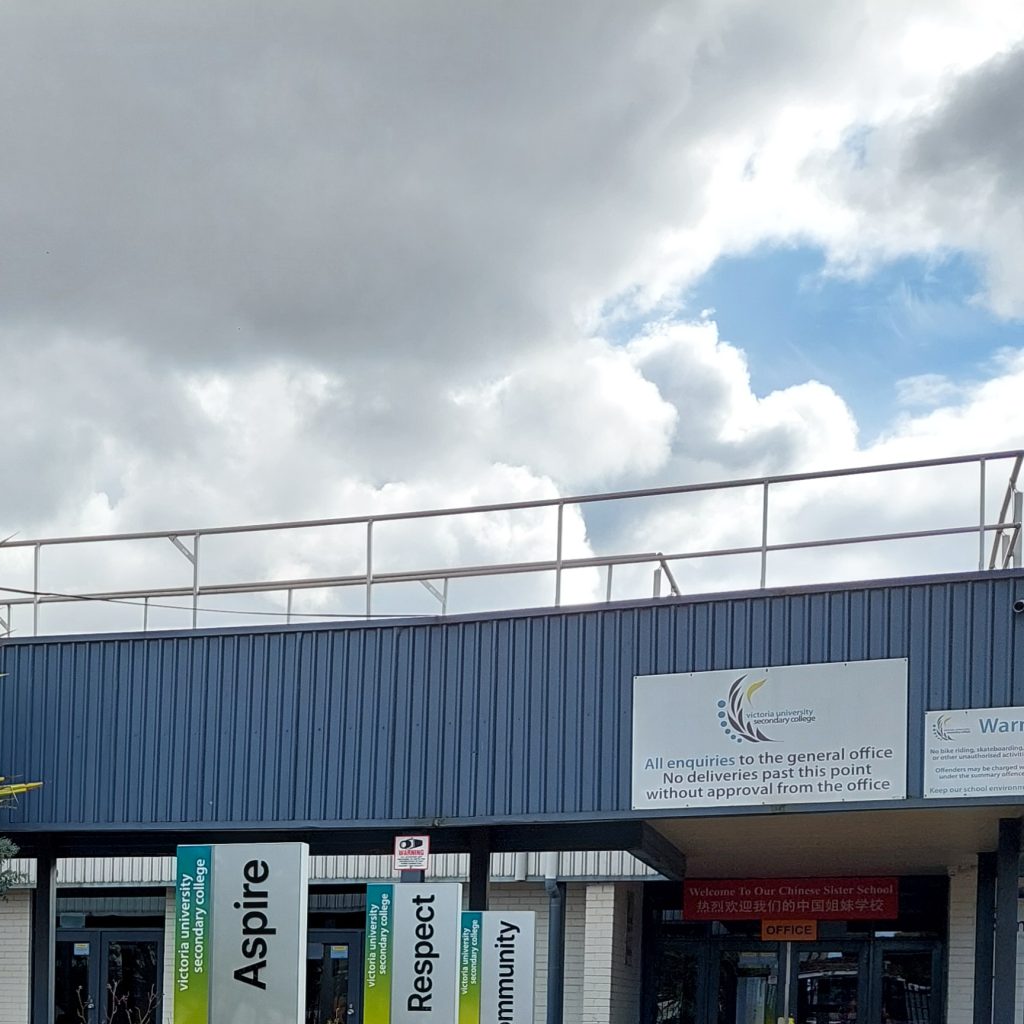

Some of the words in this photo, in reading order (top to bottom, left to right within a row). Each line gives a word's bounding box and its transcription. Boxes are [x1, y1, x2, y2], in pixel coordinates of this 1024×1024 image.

[746, 710, 774, 718] victoria
[776, 708, 814, 716] university
[754, 716, 790, 724] secondary
[791, 715, 816, 723] college
[645, 757, 663, 770] All
[667, 755, 735, 771] enquiries
[740, 755, 754, 766] to
[758, 752, 783, 764] the
[788, 748, 844, 766] general
[850, 746, 893, 760] office
[663, 772, 684, 784] No
[687, 768, 758, 783] deliveries
[762, 767, 794, 782] past
[798, 764, 826, 778] this
[830, 763, 872, 779] point
[646, 786, 703, 800] without
[707, 782, 773, 800] approval
[777, 782, 813, 795] from
[817, 780, 842, 792] the
[846, 778, 890, 791] office
[193, 859, 207, 904] college
[689, 887, 736, 897] Welcome
[738, 887, 751, 896] To
[754, 886, 775, 896] Our
[778, 886, 821, 896] Chinese
[823, 885, 855, 895] Sister
[857, 884, 893, 894] School
[179, 874, 193, 939] university
[380, 893, 390, 926] college
[192, 907, 207, 973] secondary
[234, 860, 276, 990] Aspire
[370, 904, 380, 950] university
[472, 920, 480, 946] college
[766, 925, 812, 935] OFFICE
[378, 927, 389, 974] secondary
[408, 894, 439, 1011] Respect
[463, 928, 472, 964] university
[178, 942, 189, 991] victoria
[368, 951, 377, 988] victoria
[470, 946, 479, 984] secondary
